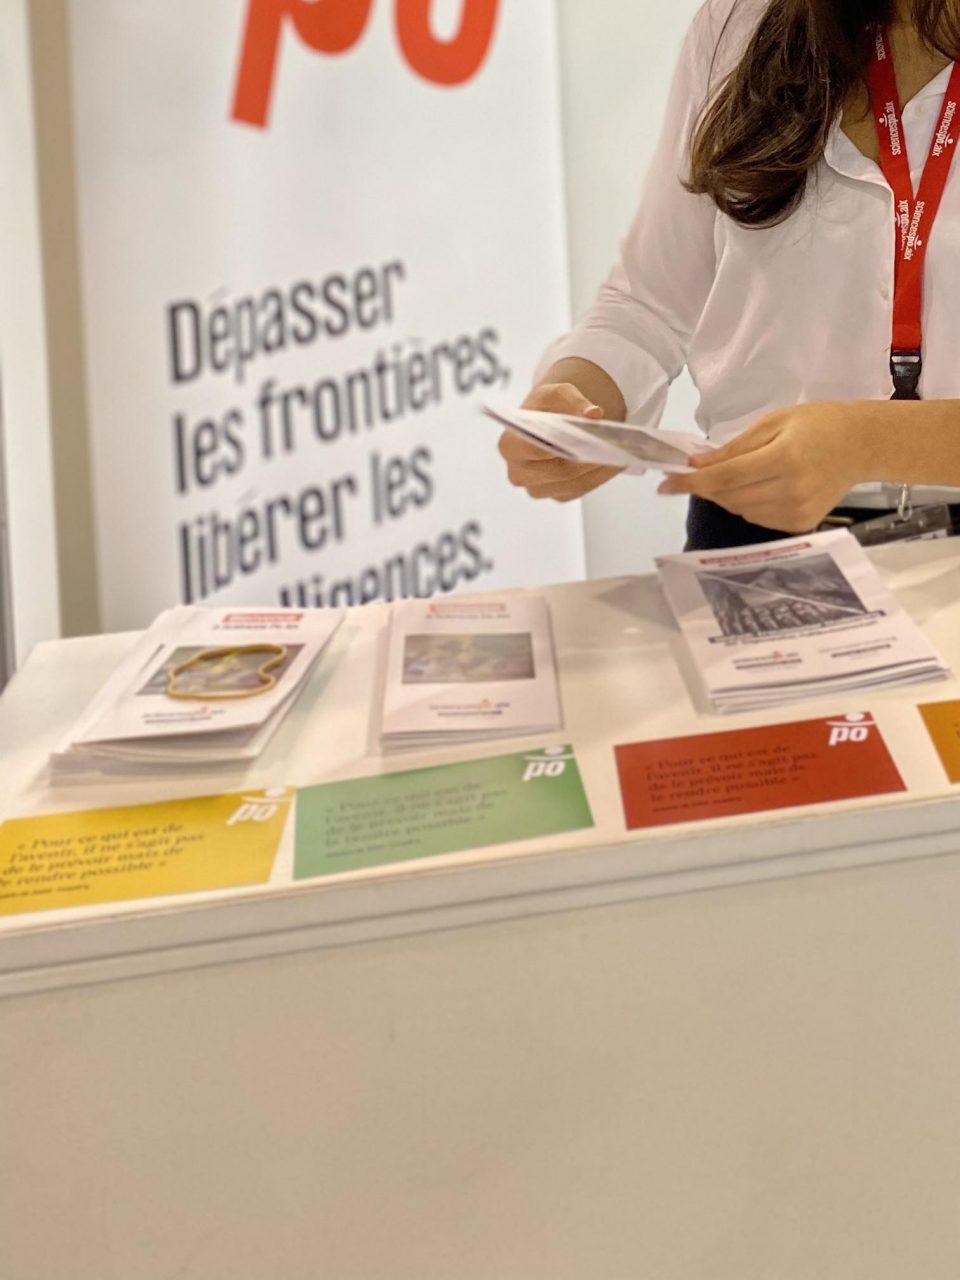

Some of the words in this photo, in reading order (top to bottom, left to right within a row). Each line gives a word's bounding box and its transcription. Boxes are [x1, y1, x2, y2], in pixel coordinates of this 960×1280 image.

[168, 260, 406, 385] Dépasser
[174, 408, 244, 495] les
[257, 326, 512, 461] frontières,
[179, 471, 358, 606] libérer
[370, 444, 434, 524] les
[522, 760, 567, 781] po
[828, 725, 869, 746] po
[226, 801, 279, 825] po
